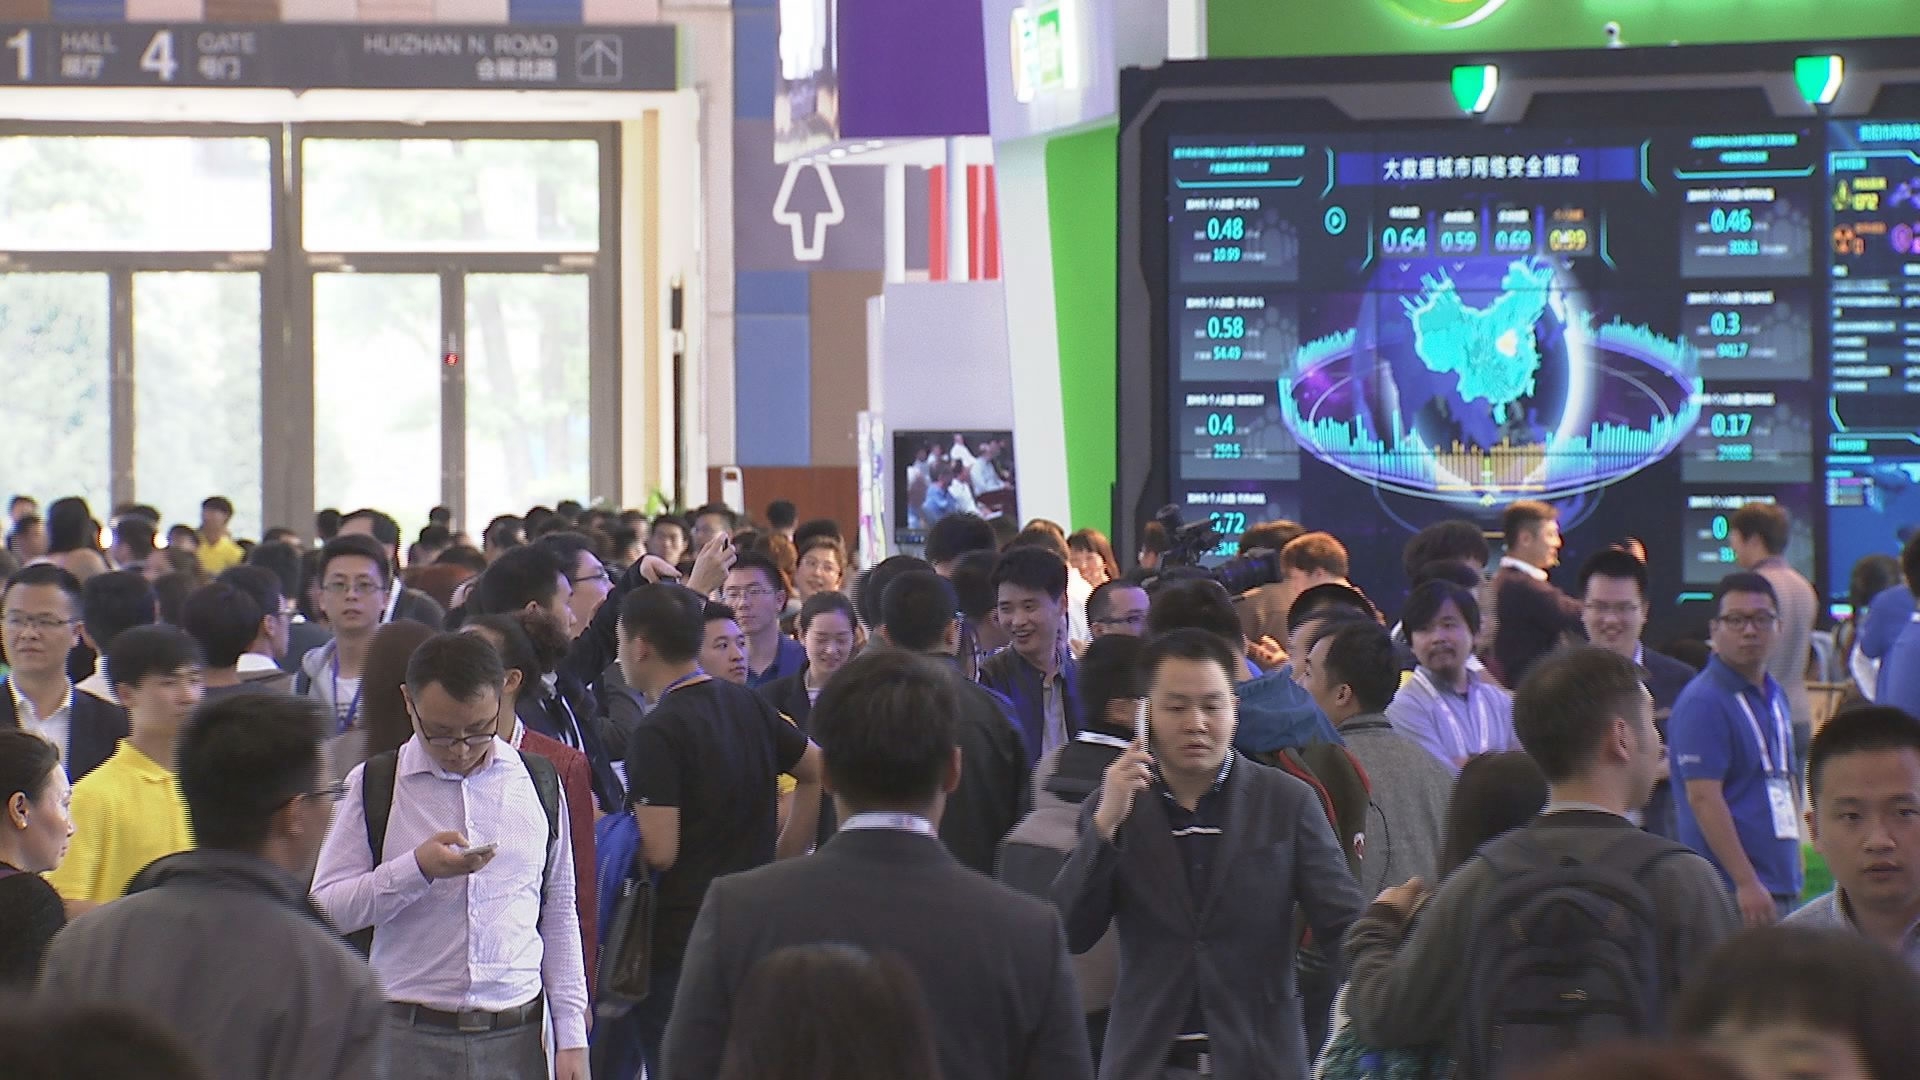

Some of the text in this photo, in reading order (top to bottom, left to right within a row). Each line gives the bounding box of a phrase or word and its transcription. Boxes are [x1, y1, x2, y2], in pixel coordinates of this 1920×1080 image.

[6, 28, 32, 80] 1
[61, 32, 117, 53] HALL
[197, 32, 256, 53] GATE
[493, 33, 558, 56] ROAD
[140, 29, 177, 81] 4
[1207, 217, 1243, 240] 0.48
[1711, 208, 1752, 233] 0.46
[1382, 227, 1427, 253] 0.64
[1207, 316, 1244, 339] 0.58
[1711, 311, 1740, 335] 0.3
[1208, 413, 1234, 436] 0.4
[1711, 413, 1752, 437] 0.17
